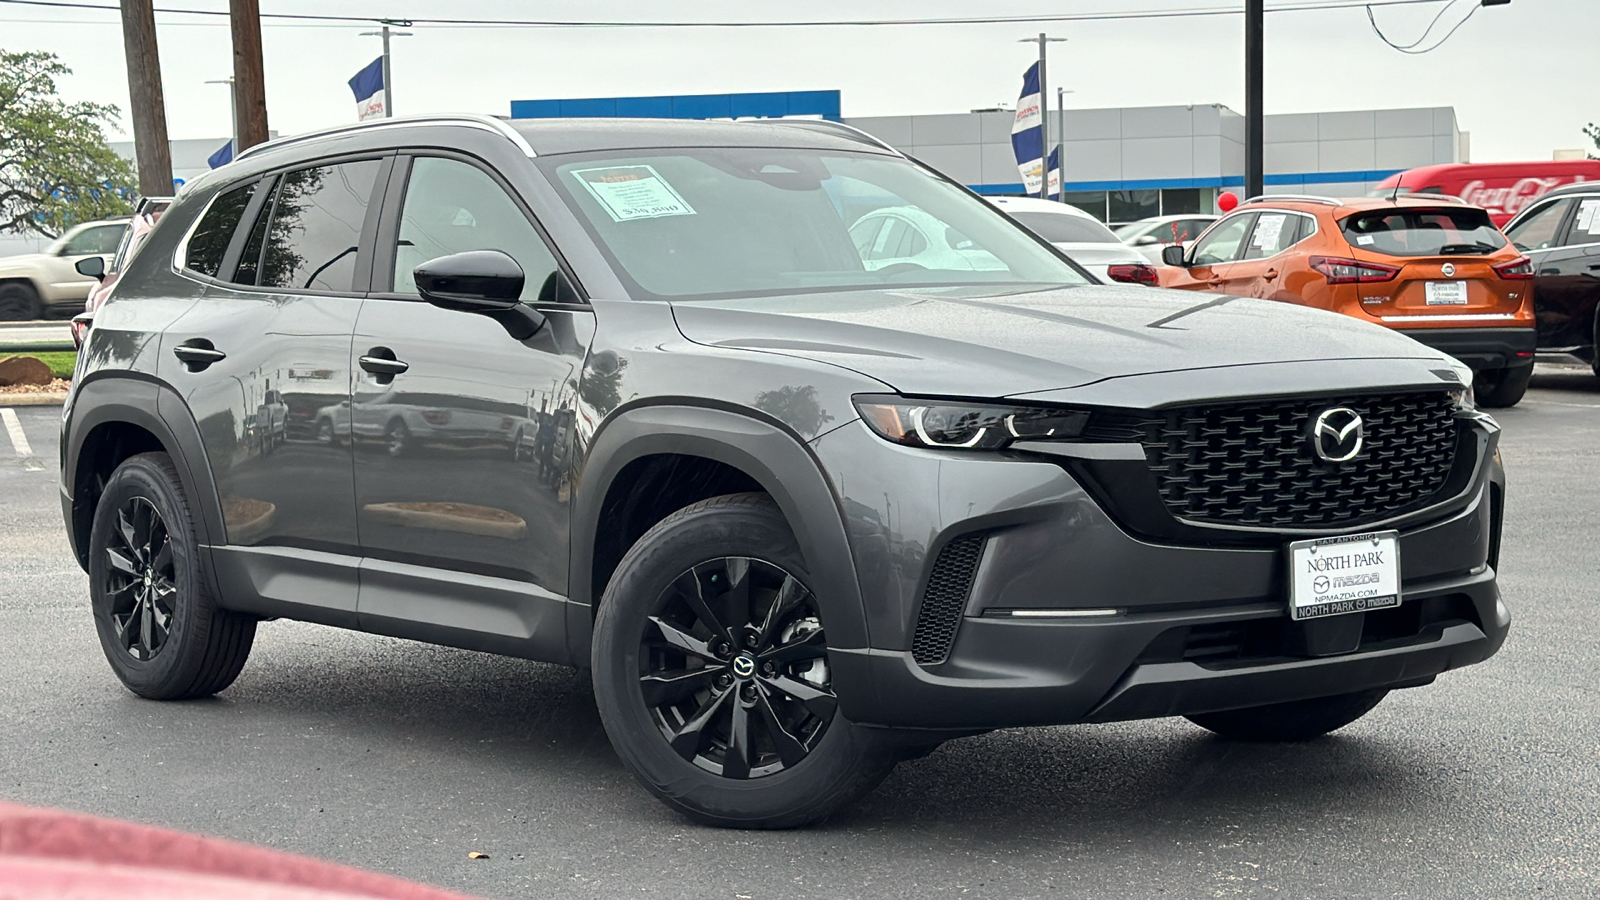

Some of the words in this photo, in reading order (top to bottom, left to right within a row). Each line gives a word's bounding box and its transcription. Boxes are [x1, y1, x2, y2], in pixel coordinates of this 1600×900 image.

[1337, 533, 1373, 544] ANTONIO
[1307, 555, 1350, 573] NORTH
[1354, 551, 1384, 567] PARK
[1333, 572, 1380, 588] mazda
[1298, 604, 1329, 618] NORTH
[1331, 600, 1354, 613] PARK
[1367, 596, 1395, 607] mazda
